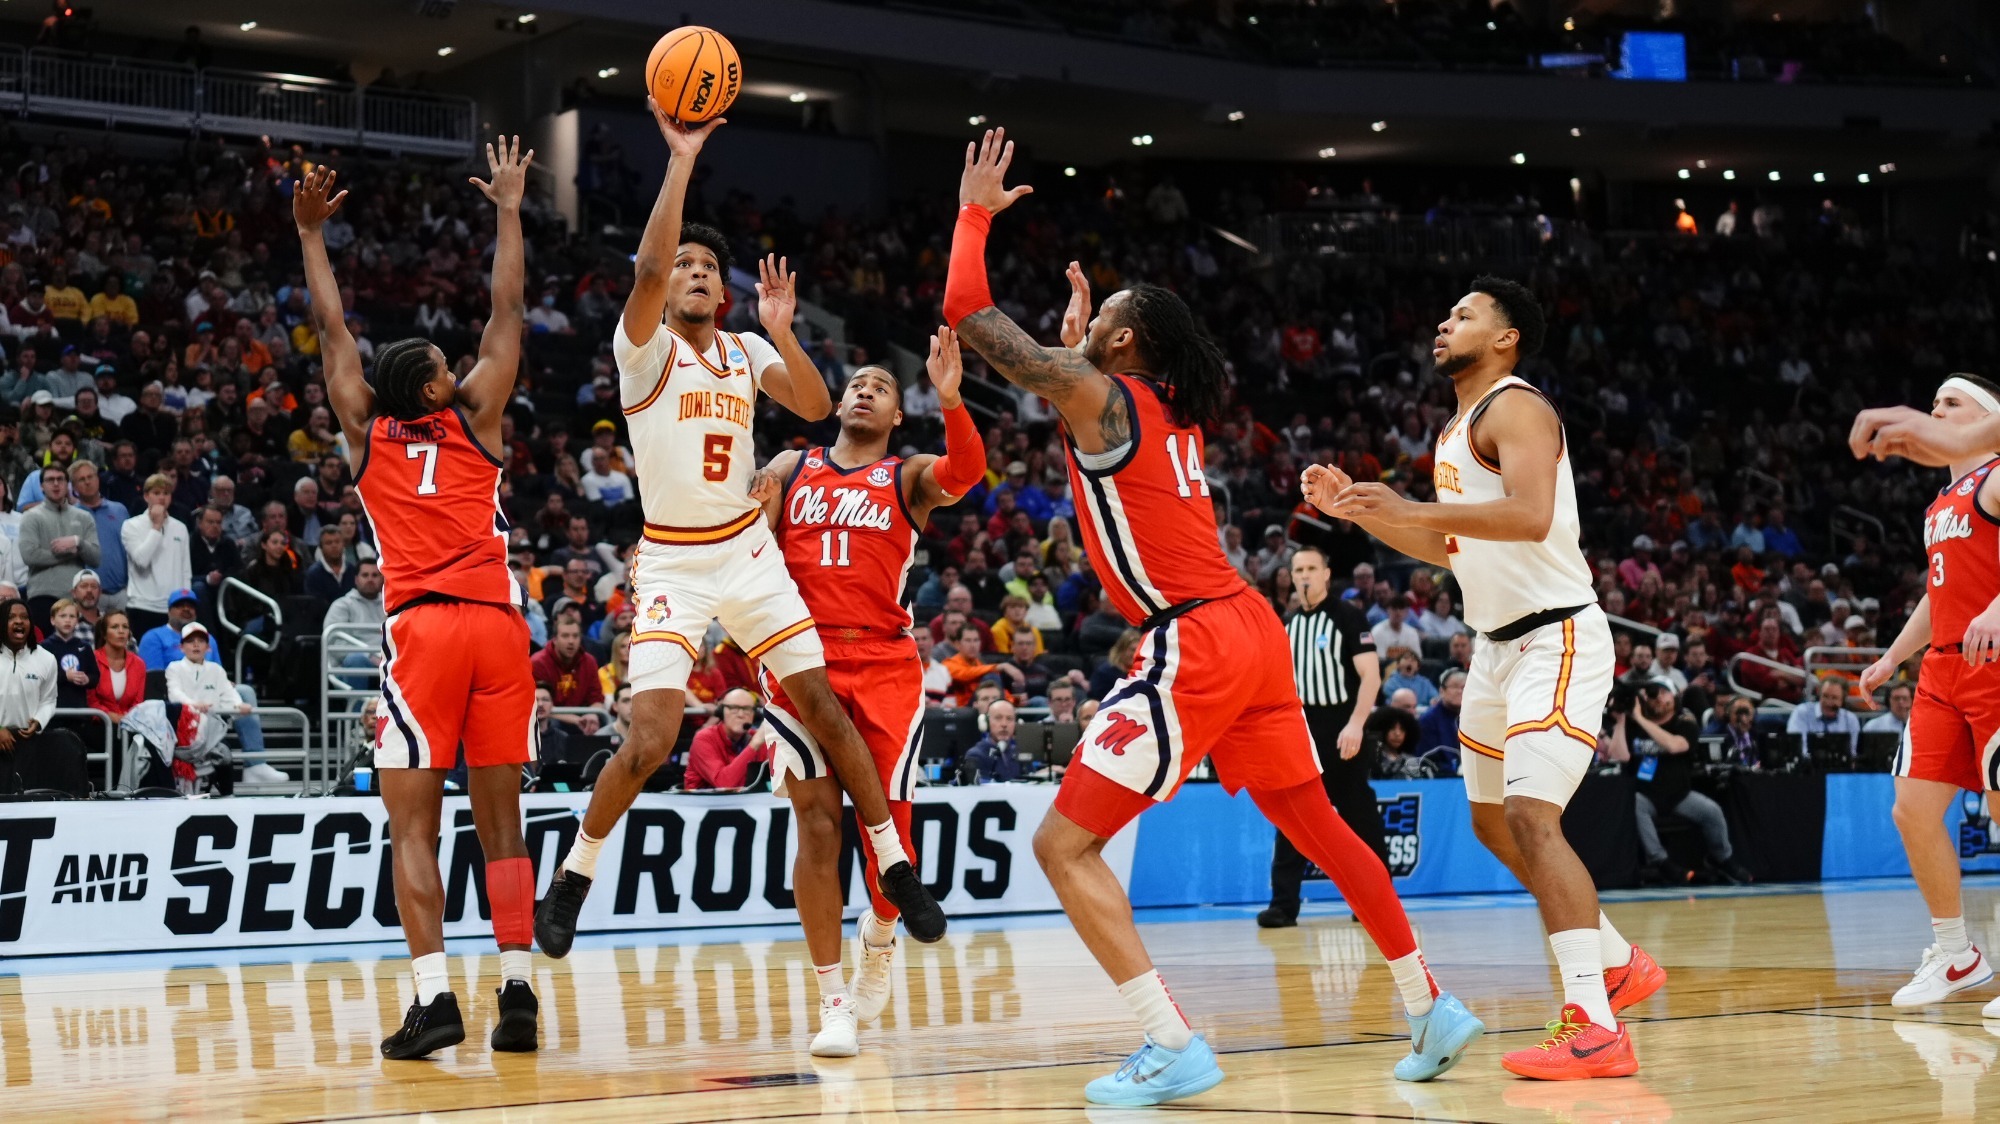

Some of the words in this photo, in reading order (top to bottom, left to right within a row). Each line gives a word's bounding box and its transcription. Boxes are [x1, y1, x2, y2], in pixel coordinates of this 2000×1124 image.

[689, 70, 715, 113] NCAA
[388, 418, 447, 441] BARNES
[679, 391, 711, 421] IOWA
[715, 392, 750, 429] STATE
[406, 442, 438, 495] 7
[703, 433, 733, 481] 5
[871, 468, 889, 482] SEC
[1166, 434, 1210, 497] 14
[790, 485, 829, 525] Ole
[830, 488, 892, 531] Miss
[1932, 505, 1972, 545] Miss
[820, 531, 850, 566] 11
[1932, 551, 1945, 587] 3
[52, 853, 148, 903] AND
